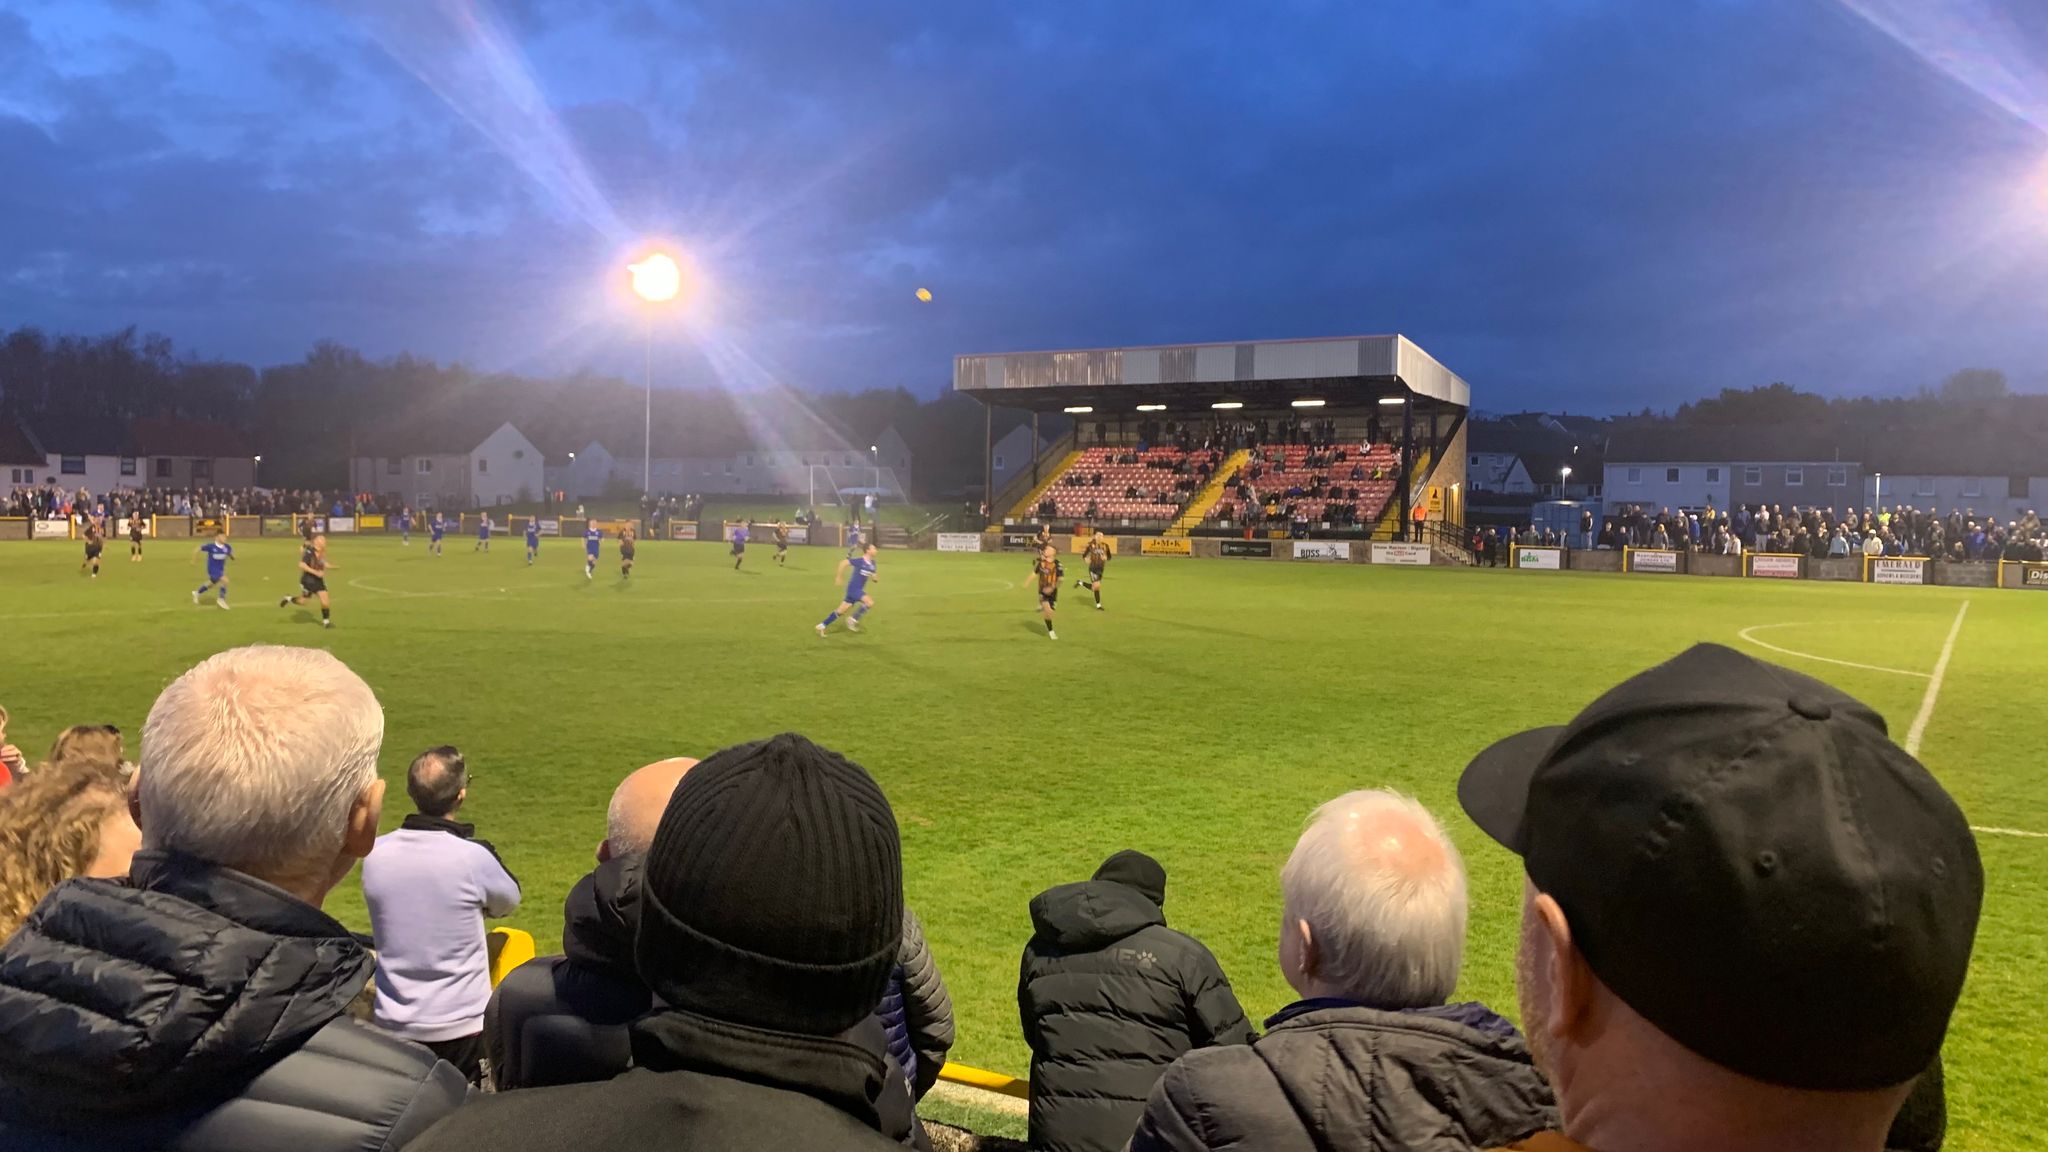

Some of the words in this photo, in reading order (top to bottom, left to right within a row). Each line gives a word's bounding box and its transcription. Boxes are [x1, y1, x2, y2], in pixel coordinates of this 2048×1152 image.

[1010, 535, 1024, 544] first
[1300, 549, 1320, 558] BOSS
[1876, 560, 1921, 569] EMERALD
